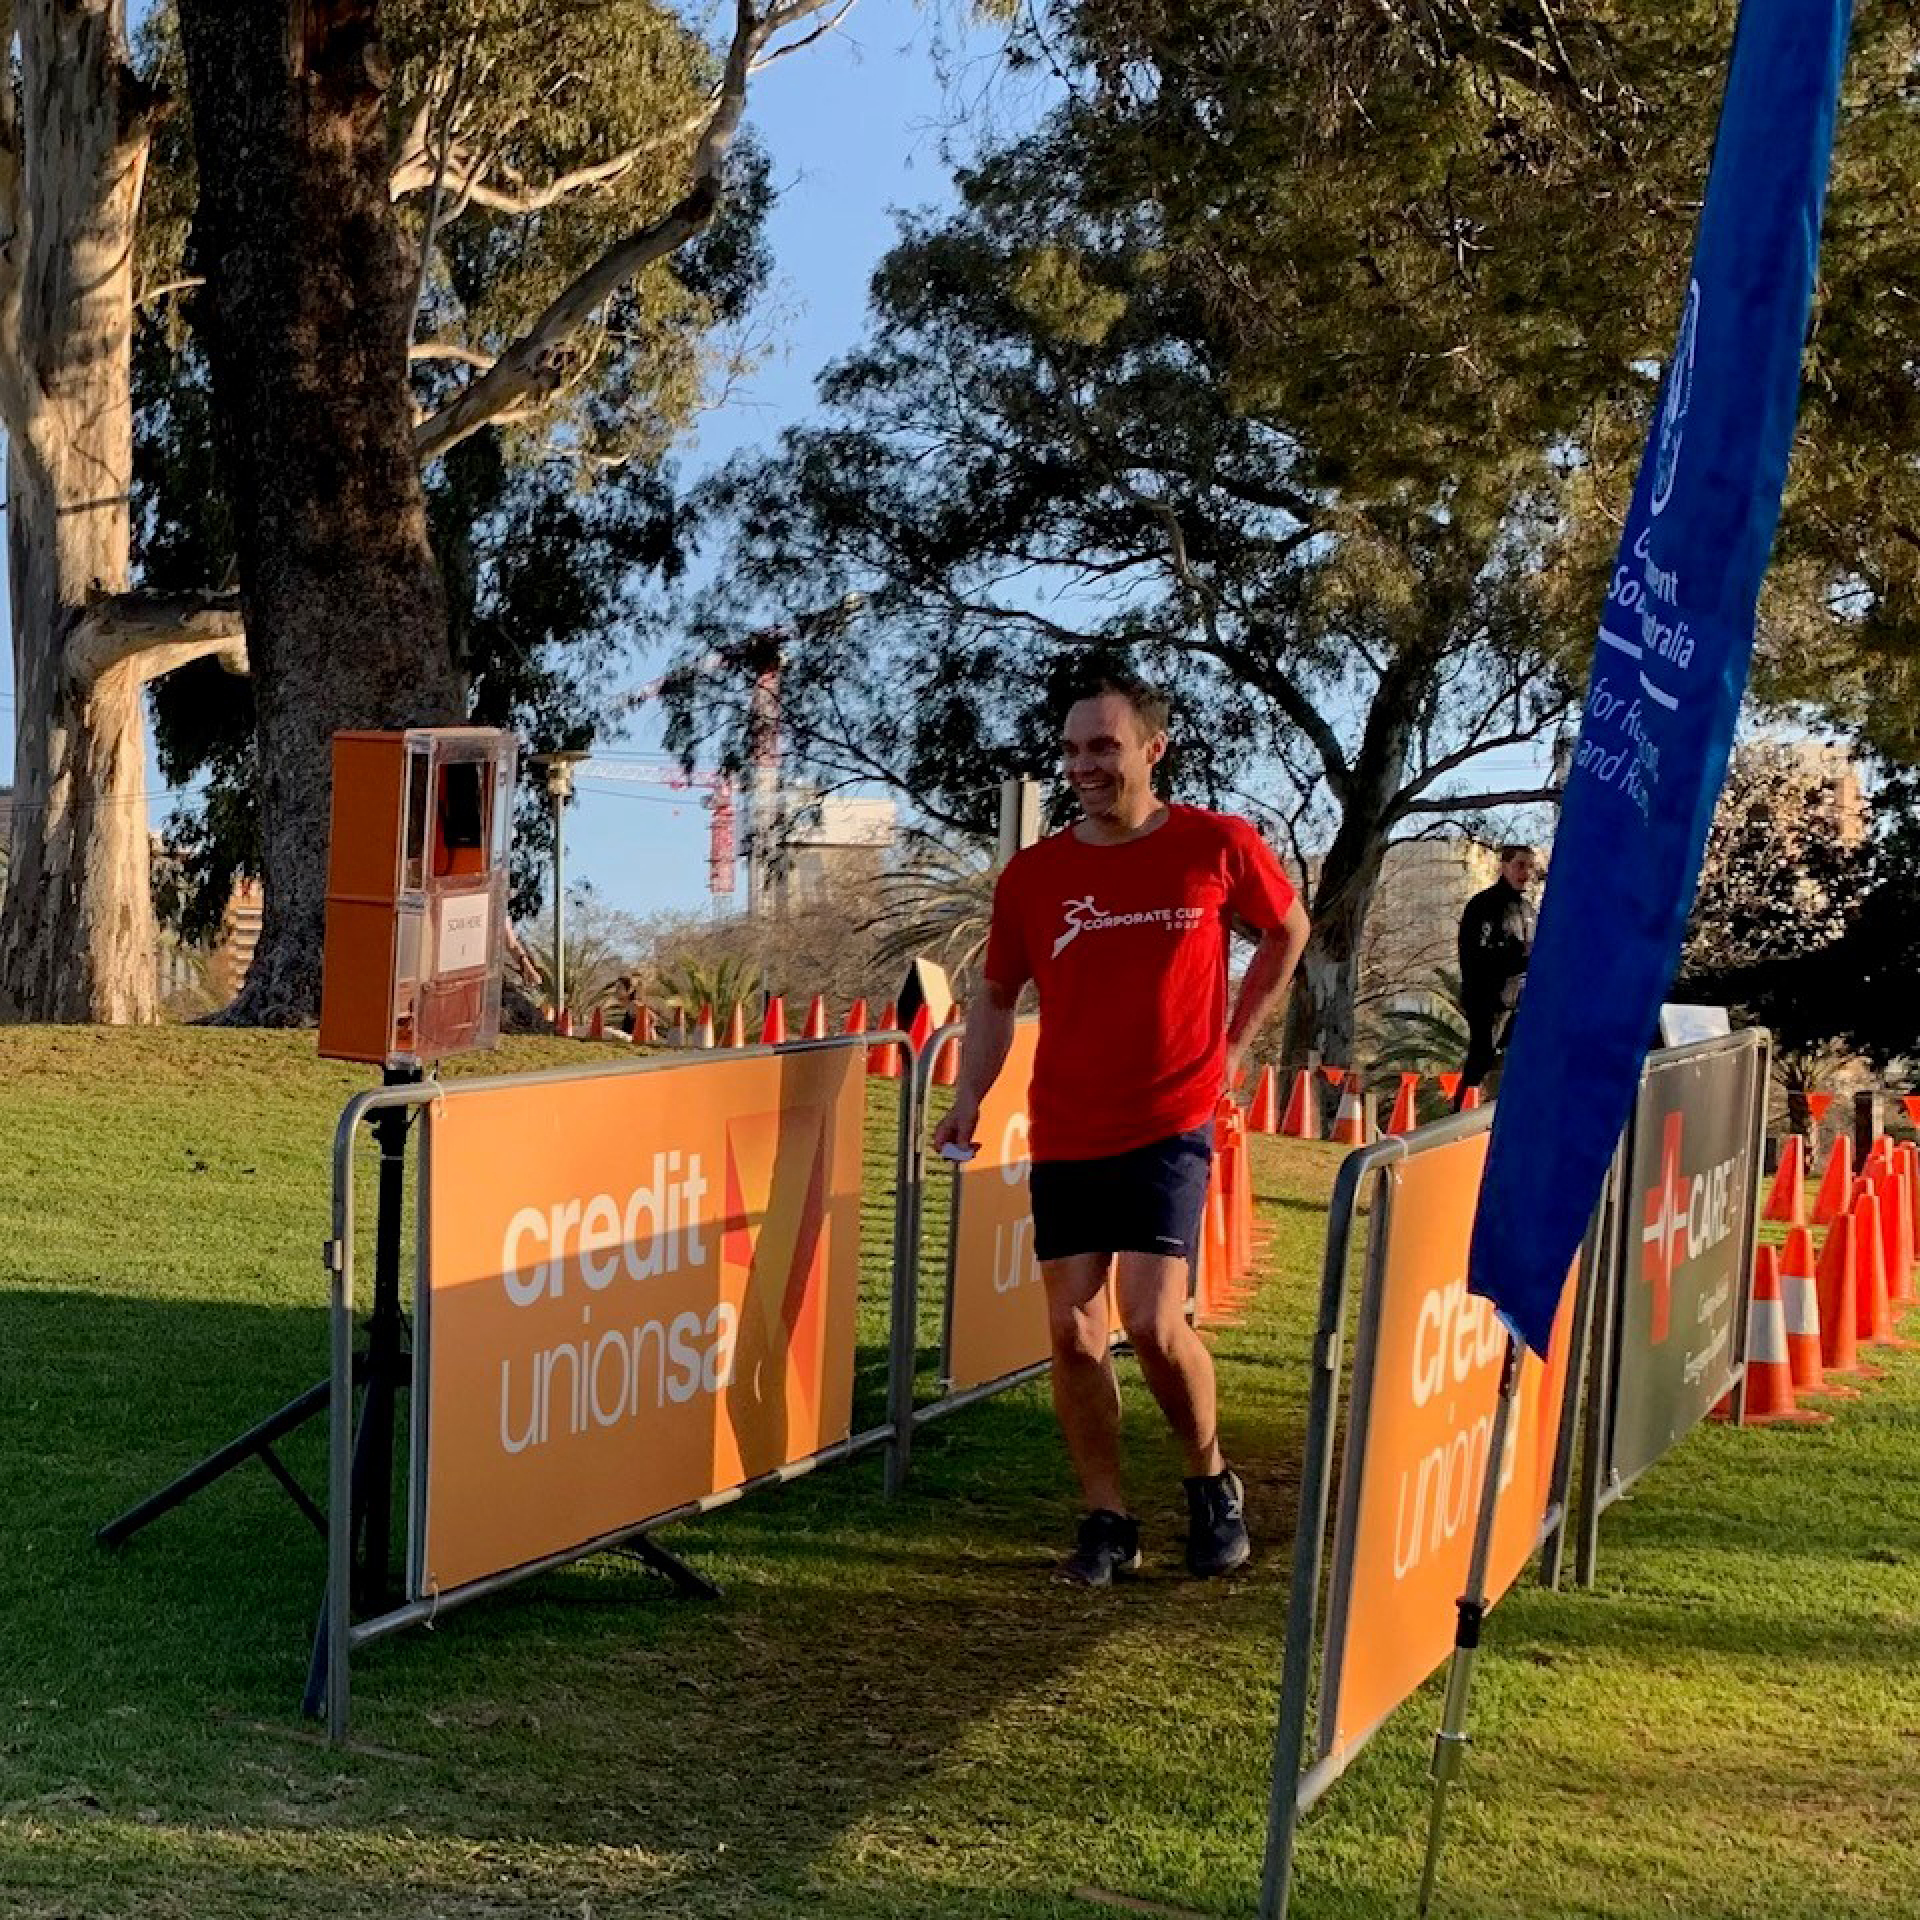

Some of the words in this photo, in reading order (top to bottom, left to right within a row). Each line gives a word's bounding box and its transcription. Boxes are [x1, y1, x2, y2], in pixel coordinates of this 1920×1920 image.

[1588, 677, 1626, 720] for
[1577, 738, 1629, 782] and
[1083, 908, 1171, 931] CORPORATE
[1175, 907, 1204, 922] CUP
[502, 1149, 708, 1307] credit
[501, 1302, 737, 1454] unionsa
